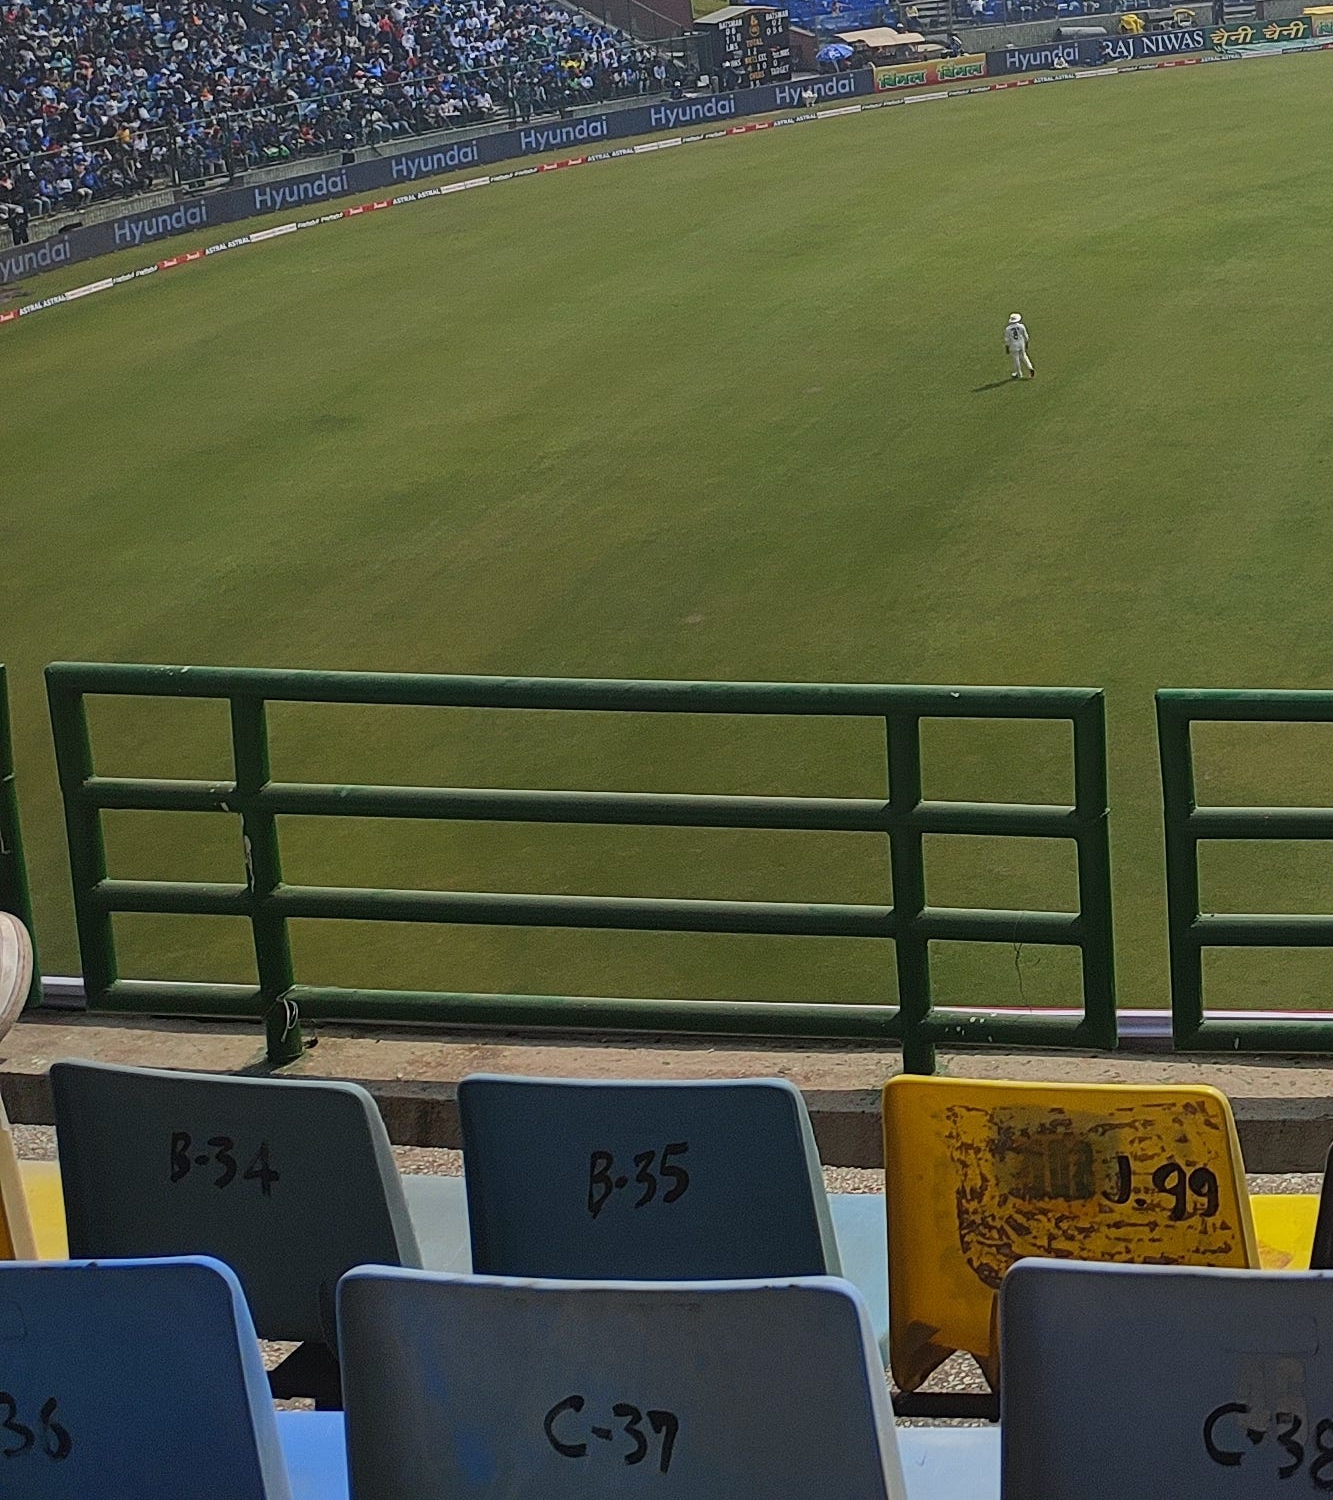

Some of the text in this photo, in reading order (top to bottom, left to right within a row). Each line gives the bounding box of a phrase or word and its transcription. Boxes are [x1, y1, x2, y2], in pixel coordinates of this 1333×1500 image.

[1006, 43, 1079, 70] Hyundai
[1102, 30, 1204, 60] RAJ NIWAS
[651, 94, 735, 127] Hyundai
[520, 116, 607, 150] Hyundai
[392, 141, 478, 179] Hyundai
[254, 170, 348, 210] Hyundai
[392, 188, 441, 205] ASTRAL ASTRAL
[114, 200, 207, 244] Hyundai
[205, 237, 250, 255] ASTRAL ASTRAL
[19, 296, 66, 316] ASTRAL ASTRAL
[170, 1130, 280, 1195] B-34
[586, 1141, 690, 1219] B-35
[543, 1394, 680, 1474] C-37
